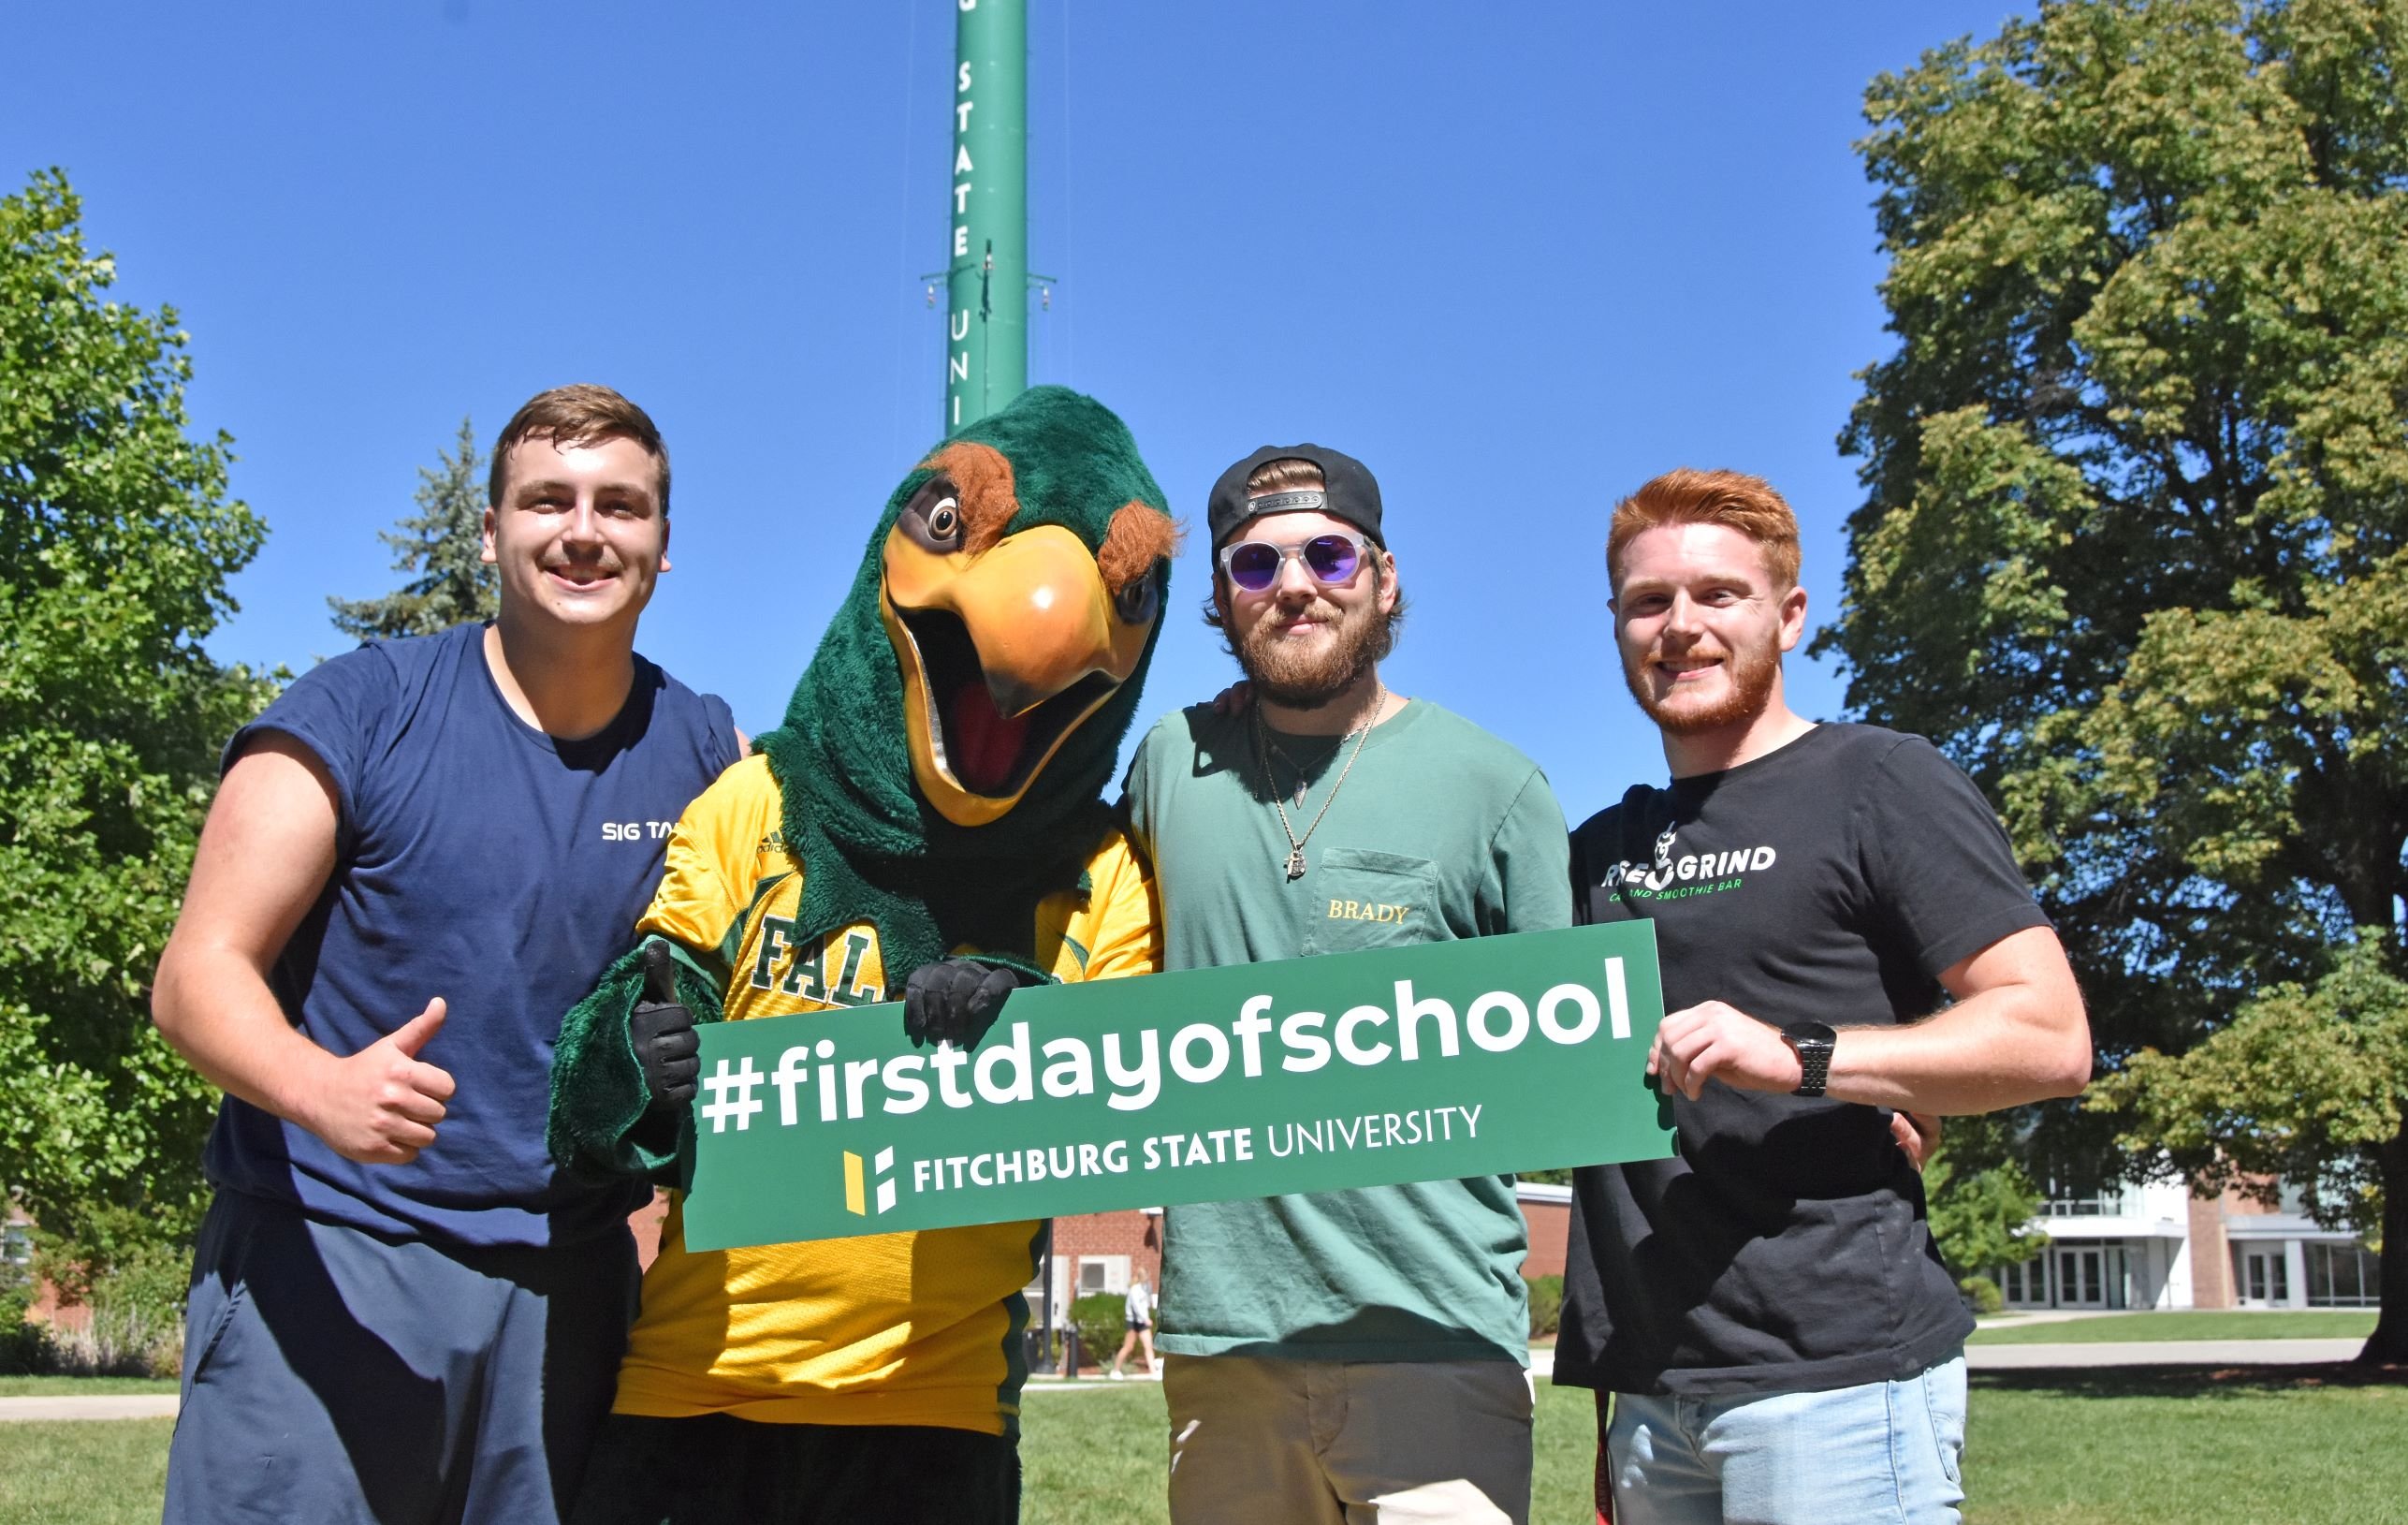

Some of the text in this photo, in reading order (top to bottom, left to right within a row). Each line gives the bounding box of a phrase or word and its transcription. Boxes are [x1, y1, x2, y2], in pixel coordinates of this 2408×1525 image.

[950, 61, 973, 425] STATE UNI
[602, 821, 678, 841] SIG TA
[1656, 884, 1715, 900] SMOOTHIE
[1717, 878, 1743, 891] BAR
[1676, 846, 1776, 880] GRIND
[1327, 899, 1409, 925] BRADY
[750, 914, 885, 1008] FAL
[701, 956, 1632, 1134] #firstdayofschool
[913, 1104, 1482, 1193] FITCHBURG STATE UNIVERSITY
